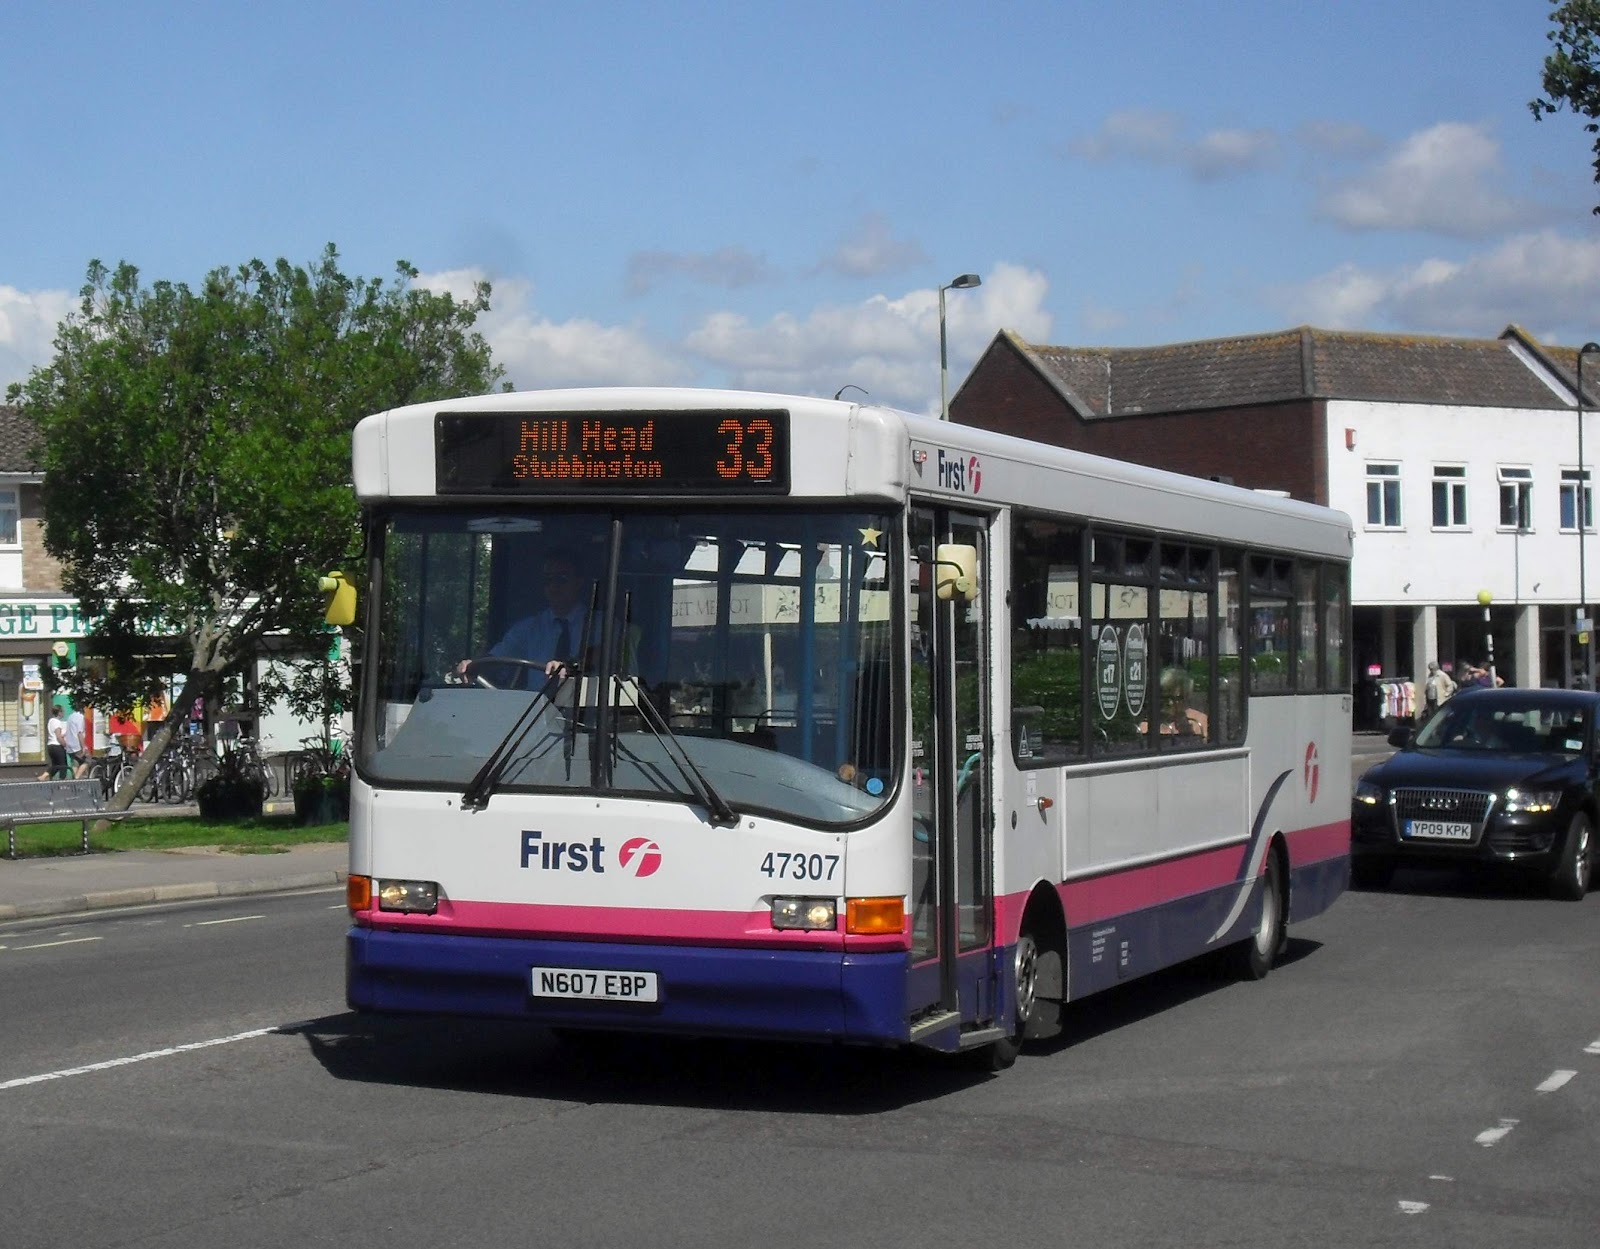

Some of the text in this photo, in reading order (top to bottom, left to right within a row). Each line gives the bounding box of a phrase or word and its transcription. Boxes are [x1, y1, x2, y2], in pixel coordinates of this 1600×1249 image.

[520, 420, 654, 451] Hill Head
[716, 418, 774, 479] 33
[512, 454, 663, 479] Stubbington
[937, 448, 966, 492] First
[1413, 822, 1444, 836] YP09
[1446, 824, 1470, 837] KPK
[520, 829, 606, 874] First
[760, 851, 840, 881] 47307
[540, 972, 648, 997] N607 EBP
